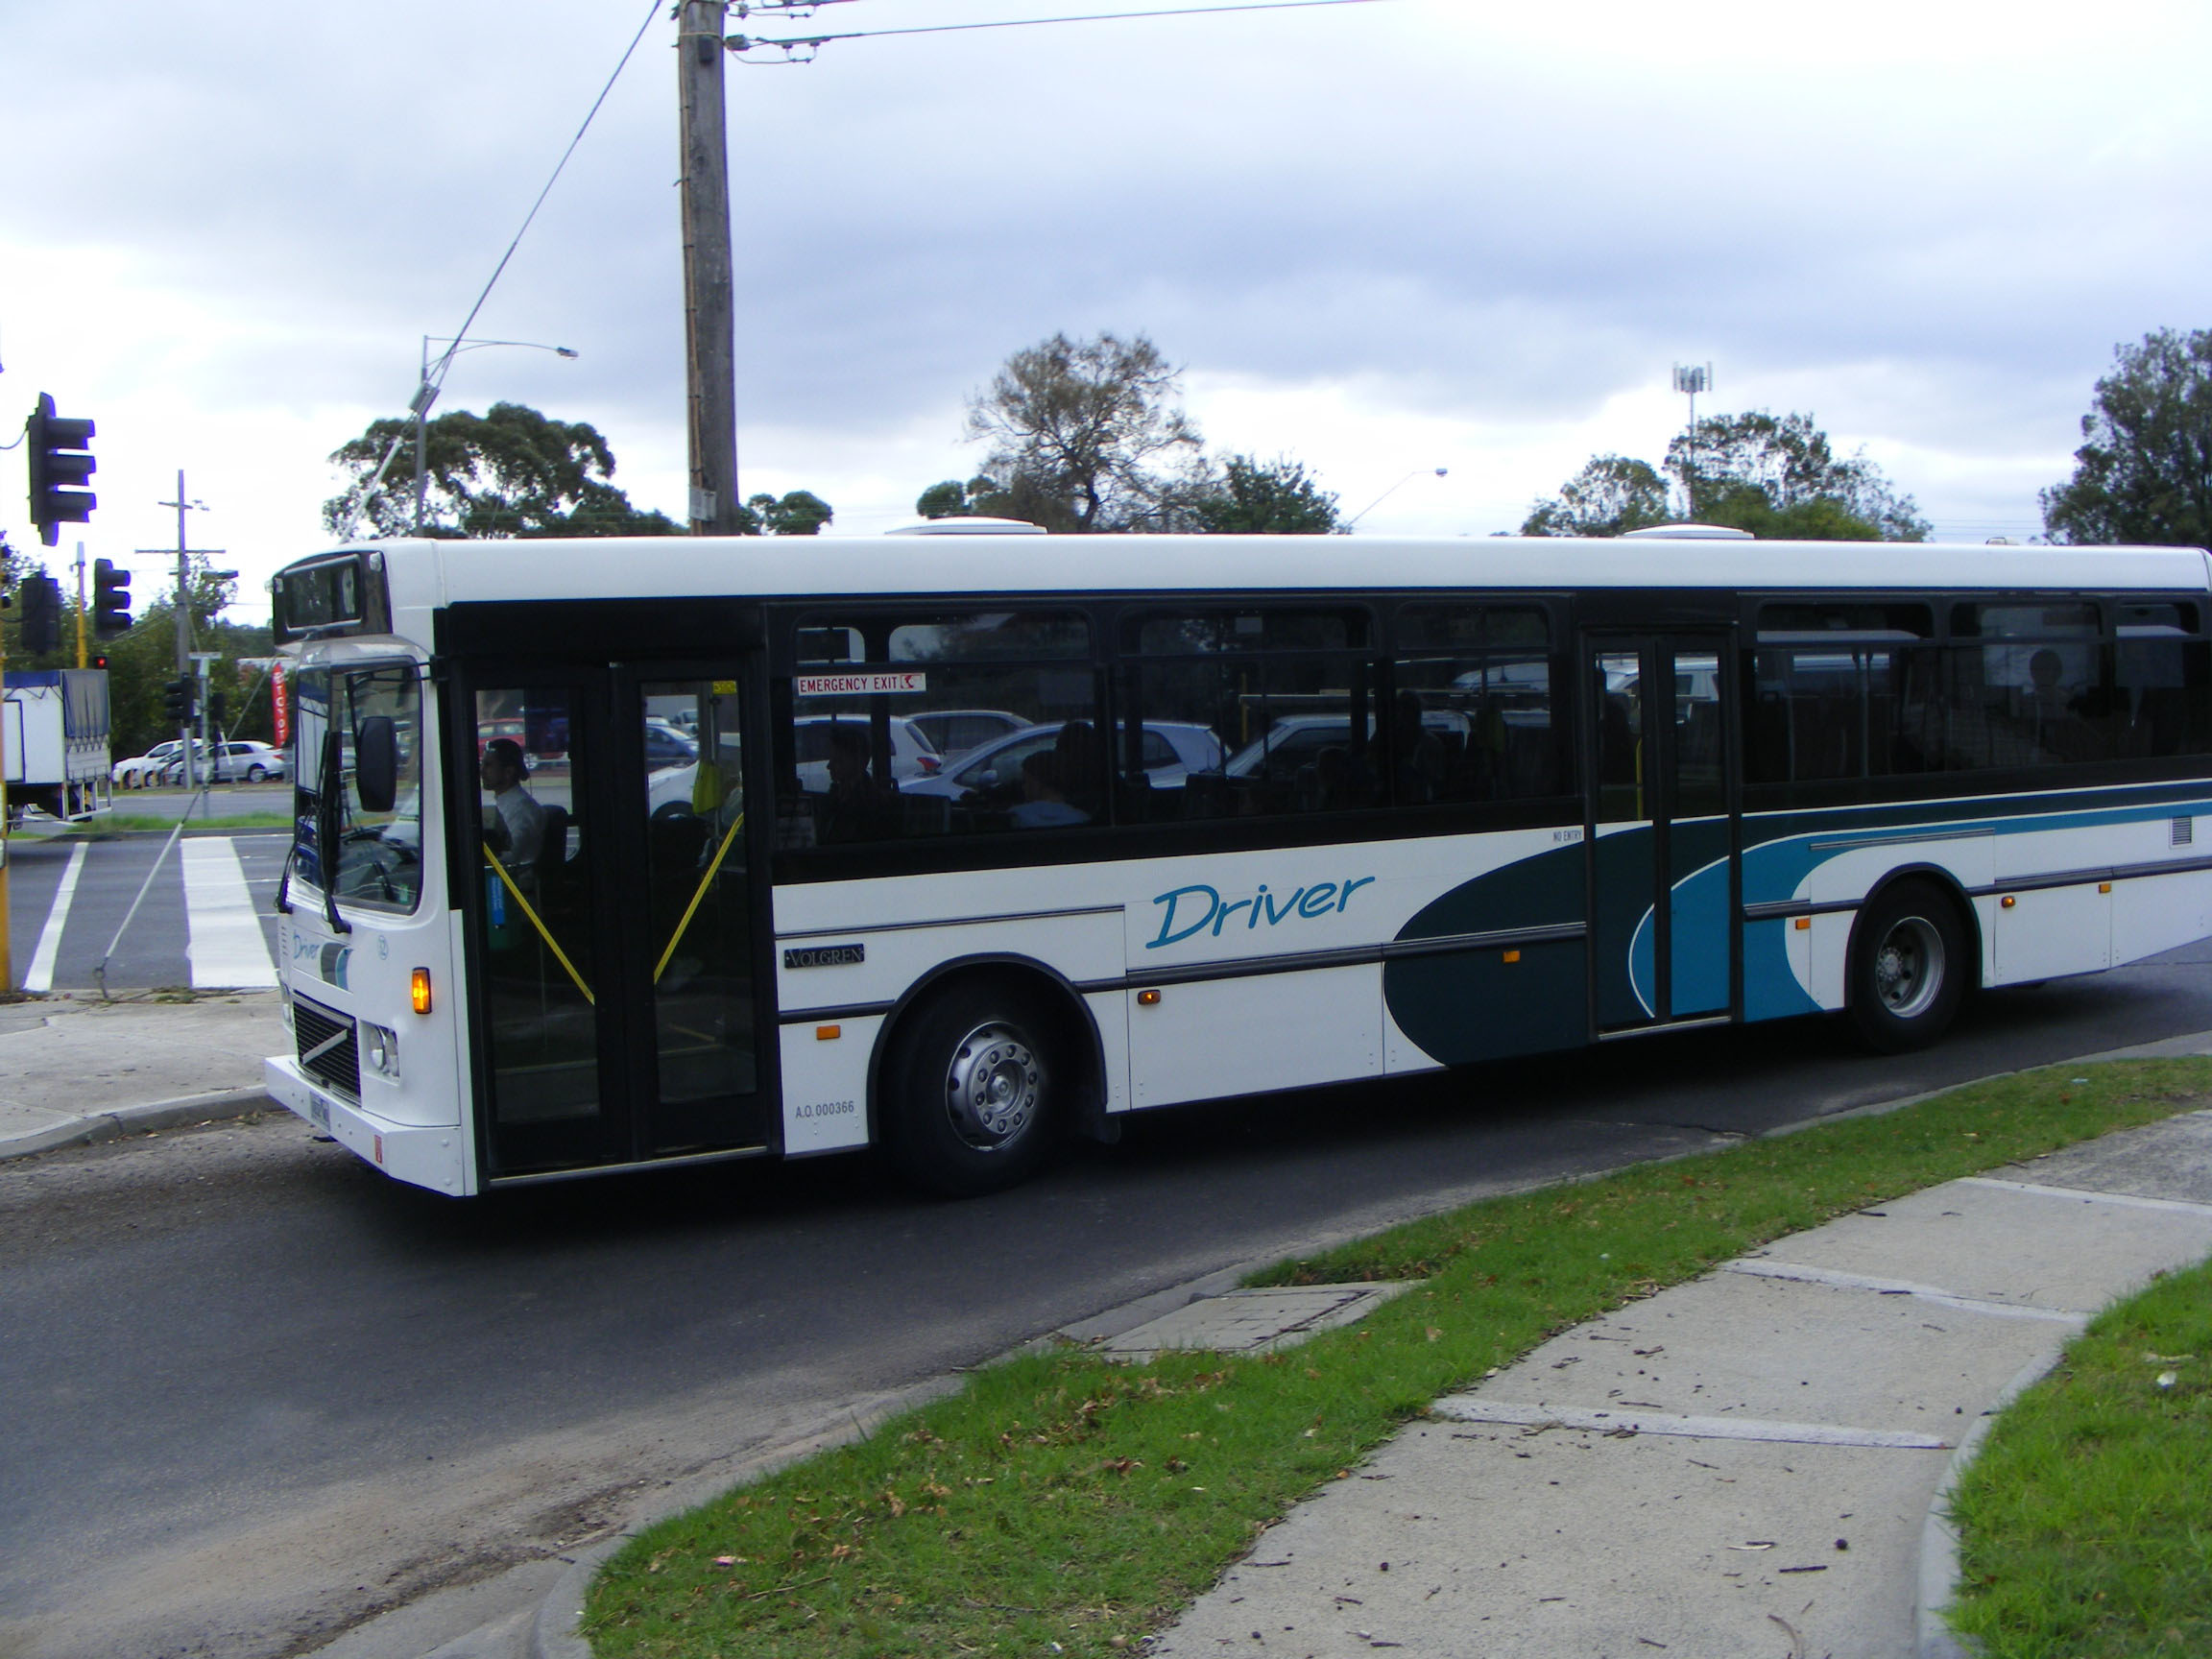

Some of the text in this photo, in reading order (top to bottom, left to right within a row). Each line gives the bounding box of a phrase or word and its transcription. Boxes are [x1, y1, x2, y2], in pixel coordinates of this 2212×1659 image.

[800, 676, 898, 693] EMERGENCY EXIT
[1564, 830, 1582, 841] ENTRY
[1145, 876, 1376, 950] Driver
[293, 931, 320, 959] Driver
[789, 947, 862, 967] VOLGREN
